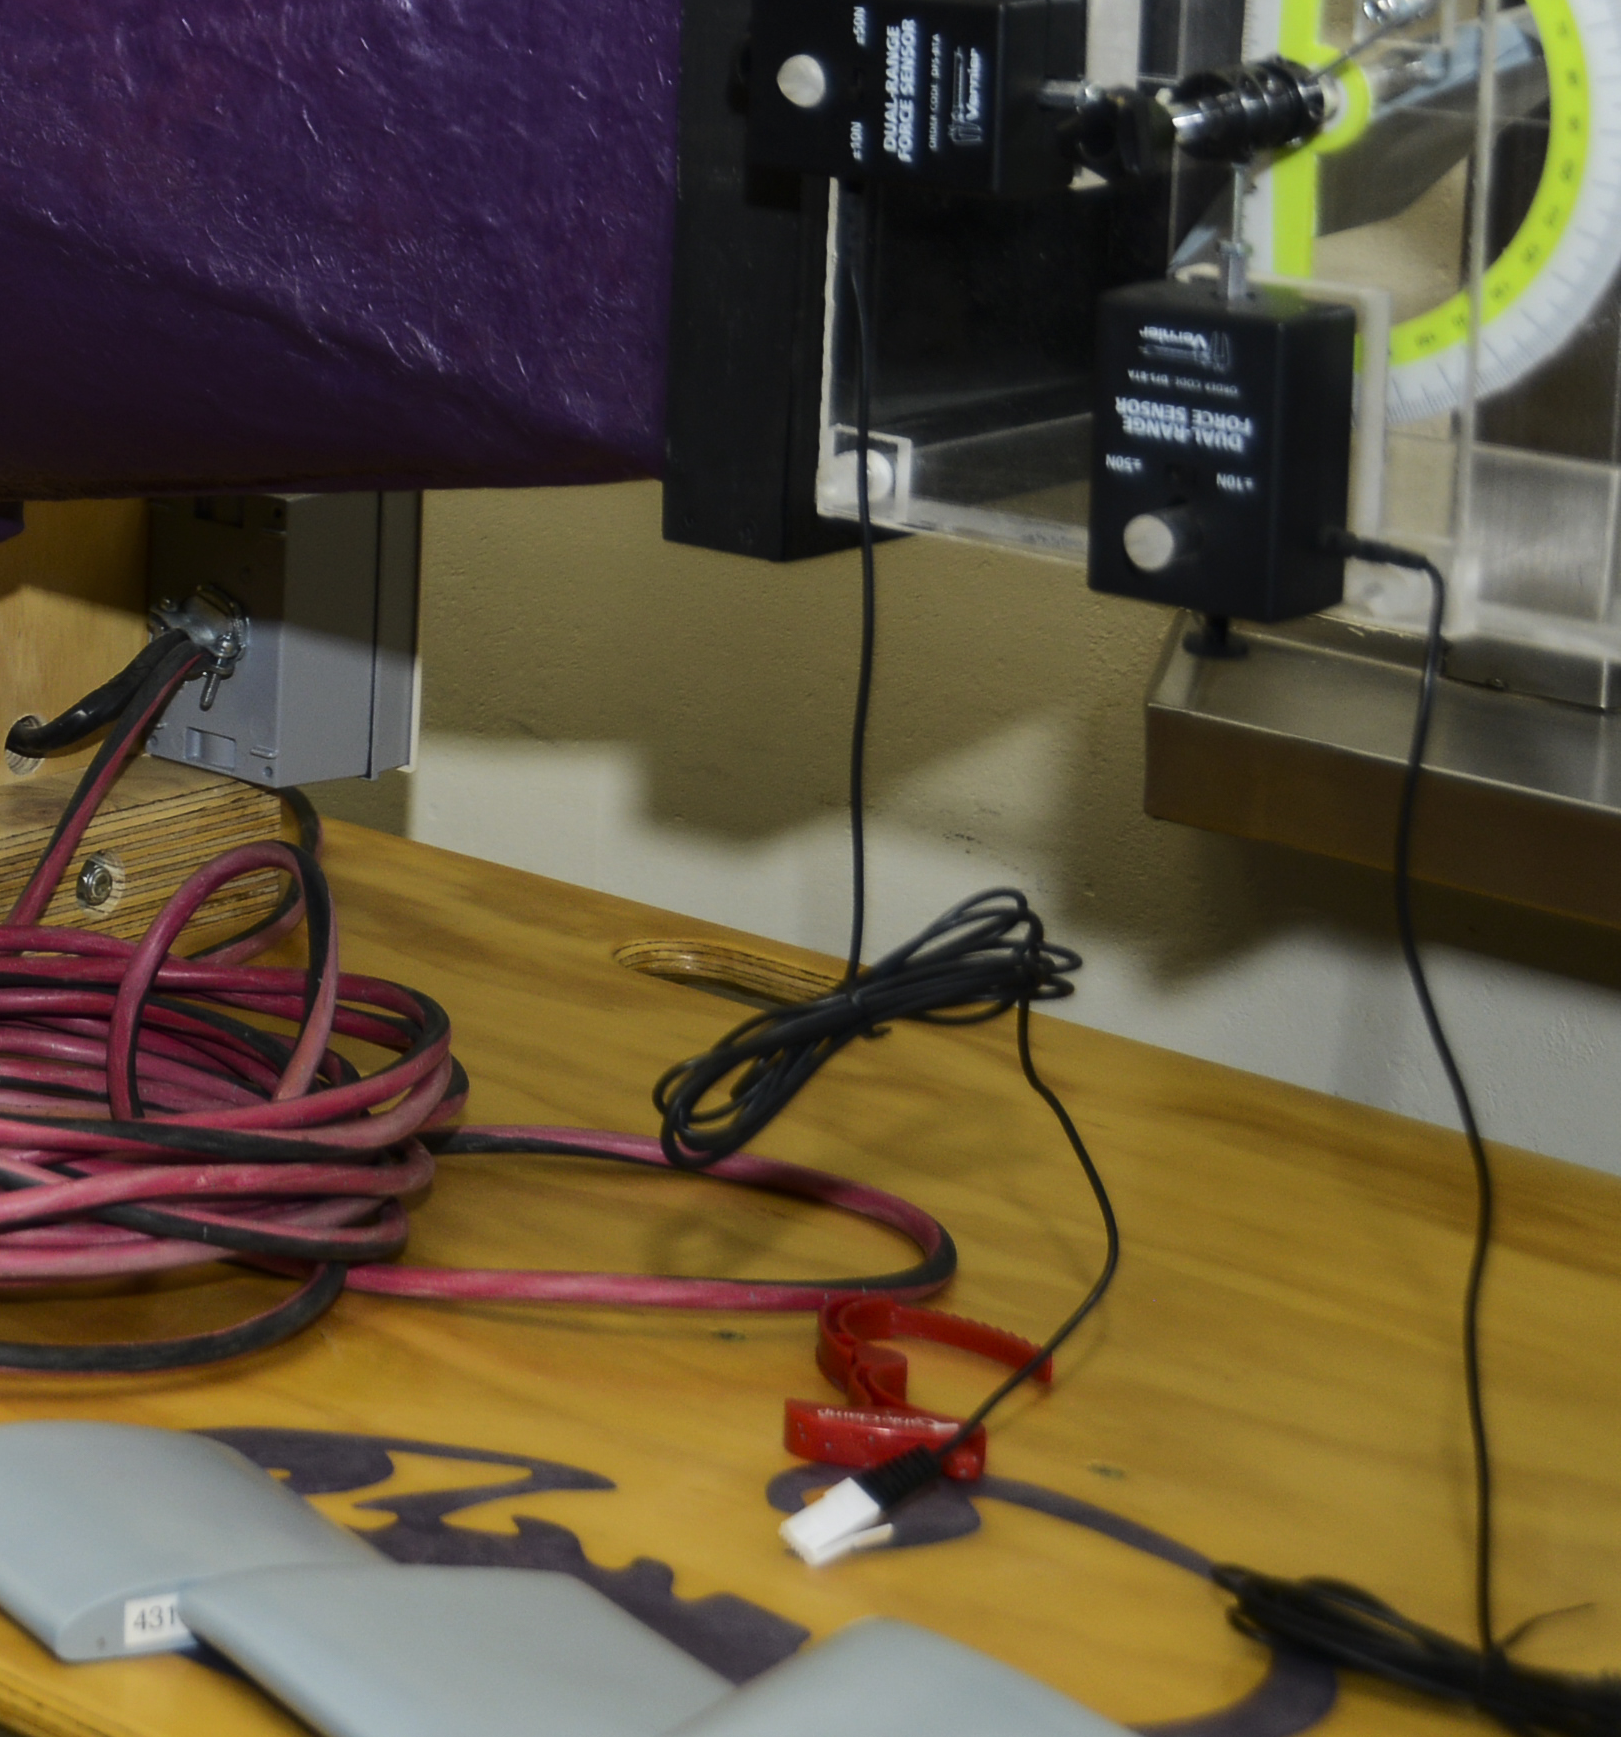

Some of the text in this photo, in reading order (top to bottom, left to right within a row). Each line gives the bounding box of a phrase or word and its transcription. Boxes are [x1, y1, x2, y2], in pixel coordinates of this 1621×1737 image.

[883, 25, 900, 153] DUAL-RANGE
[898, 18, 916, 163] FORCE SENSOR
[965, 47, 981, 120] Vernier
[1138, 325, 1207, 350] Vernier
[1115, 396, 1252, 437] FORCE SENSOR
[1122, 415, 1244, 454] DUAL-RANGE
[134, 1604, 174, 1630] 431
